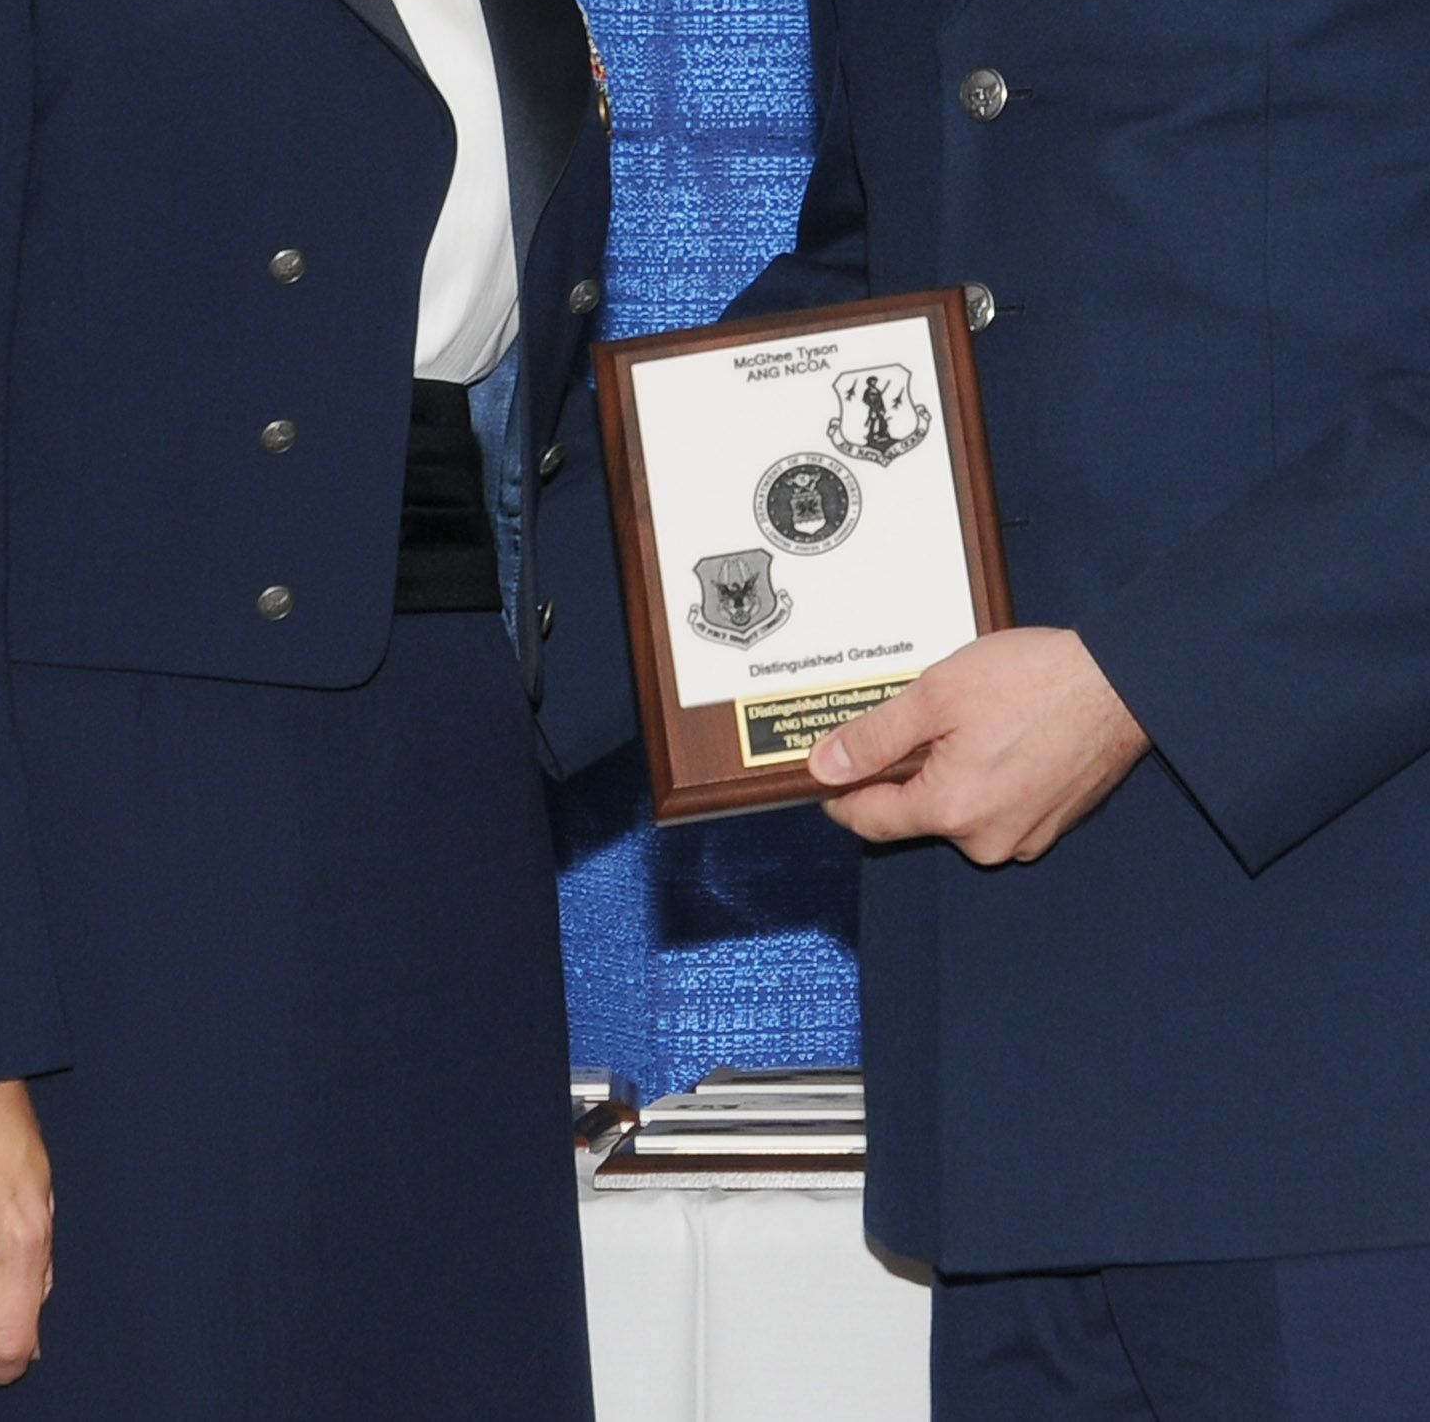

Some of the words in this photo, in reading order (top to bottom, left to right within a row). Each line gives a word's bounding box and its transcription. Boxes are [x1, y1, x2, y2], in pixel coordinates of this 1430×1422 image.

[733, 351, 793, 370] McGhee
[796, 343, 839, 361] Tyson
[746, 366, 780, 382] ANG
[784, 358, 831, 376] NCOA
[827, 459, 843, 474] AIR
[749, 650, 844, 677] Distinguished
[847, 641, 914, 661] Graduate
[748, 694, 828, 720] Distinguished
[829, 688, 882, 706] Graduate
[772, 718, 801, 733] ANG
[801, 712, 837, 729] NCOA
